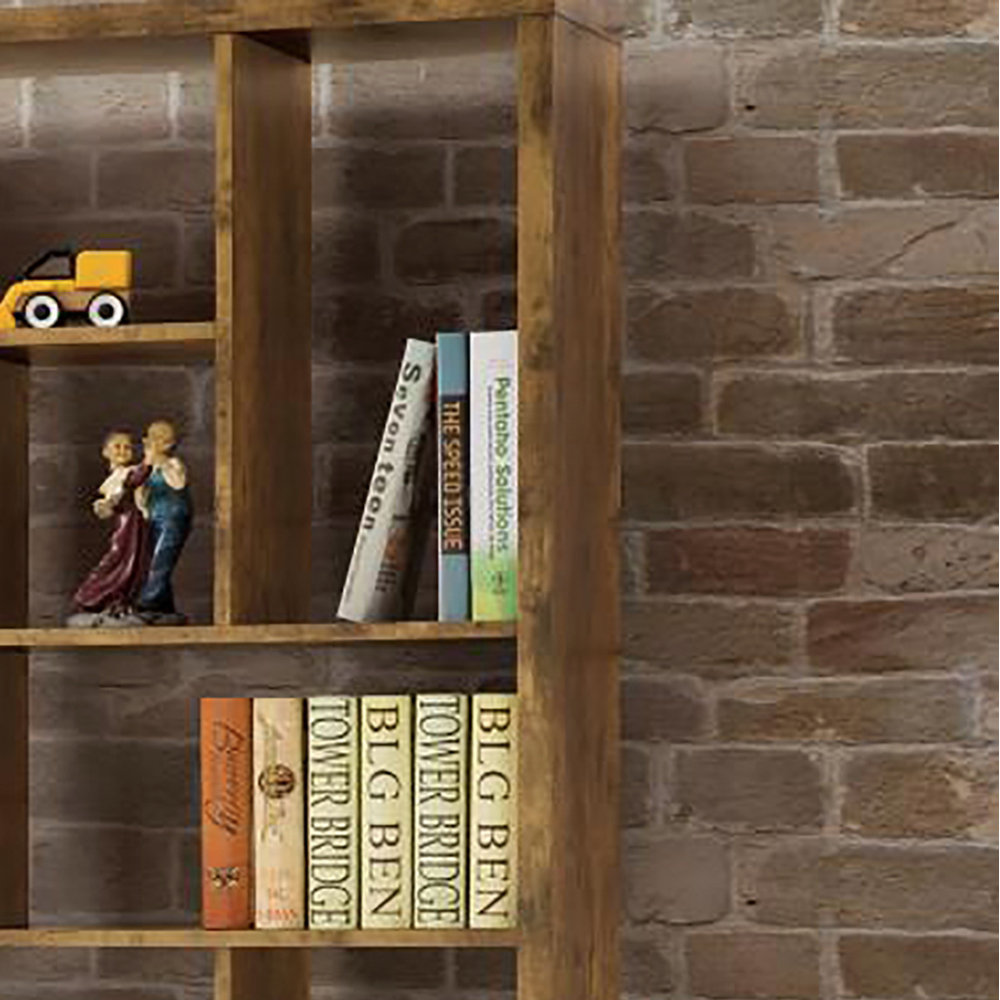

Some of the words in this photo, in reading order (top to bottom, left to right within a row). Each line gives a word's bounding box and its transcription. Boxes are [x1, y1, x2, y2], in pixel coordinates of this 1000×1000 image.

[443, 401, 461, 434] THE
[443, 439, 462, 494] SPEED
[495, 462, 512, 552] Solutions
[443, 496, 463, 551] ISSUE
[311, 698, 352, 807] TOWER
[416, 697, 460, 804] TOWER
[311, 816, 351, 925] BRIDGE
[368, 823, 402, 918] BEN
[417, 814, 460, 924] BRIDGE
[477, 823, 510, 918] BEN
